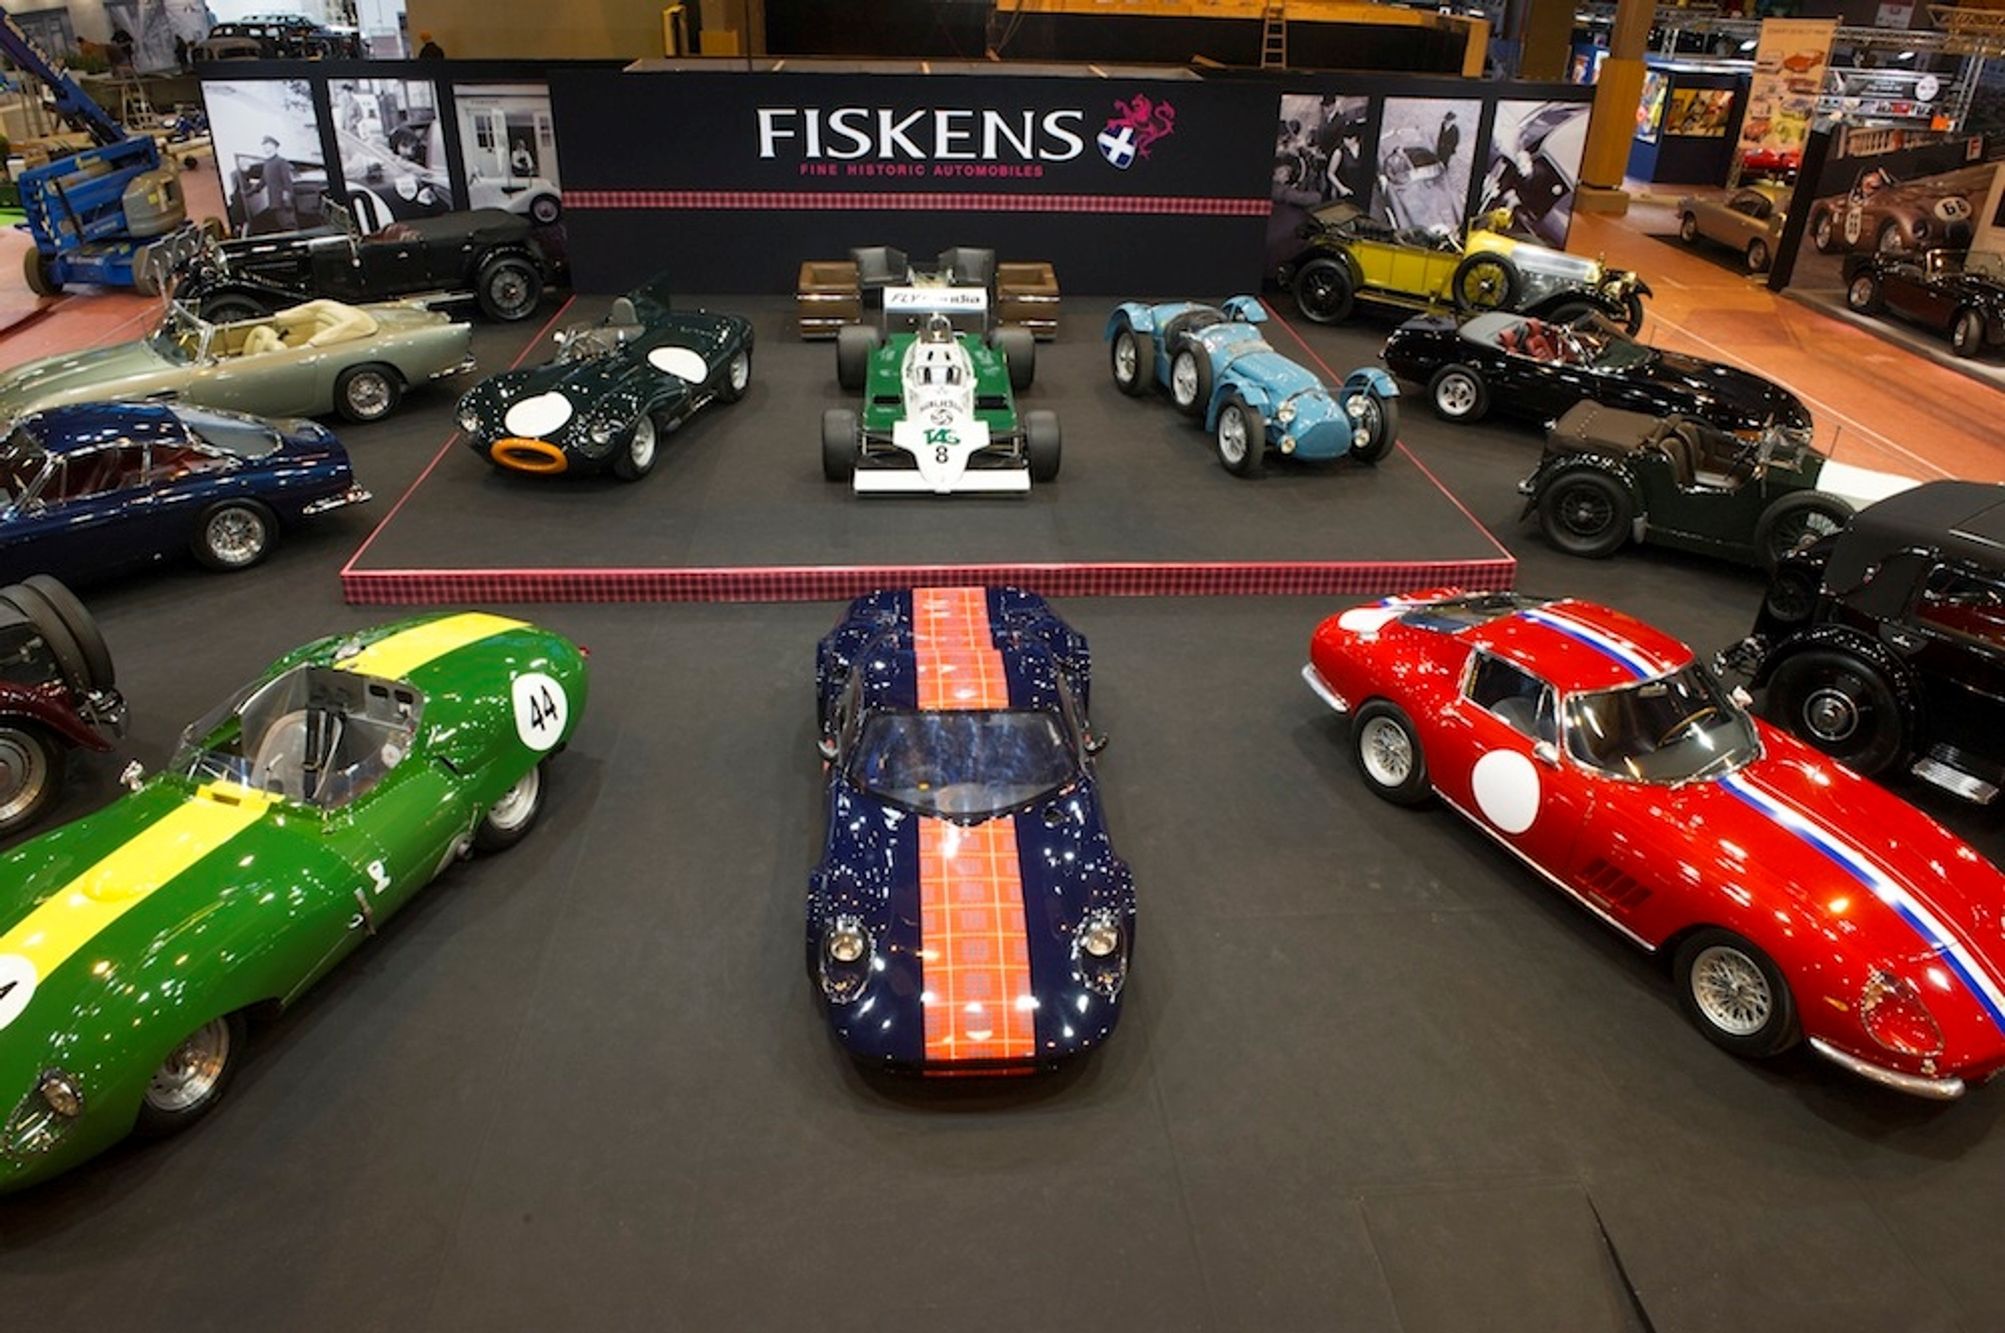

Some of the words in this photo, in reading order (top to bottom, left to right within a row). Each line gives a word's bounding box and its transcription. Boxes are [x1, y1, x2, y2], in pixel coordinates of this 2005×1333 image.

[757, 108, 1085, 161] FISKENS
[800, 163, 838, 177] FINE
[847, 164, 926, 177] HISTORIC
[933, 165, 1044, 178] AUTOMOBILES
[935, 445, 949, 464] 8
[530, 684, 559, 732] 44
